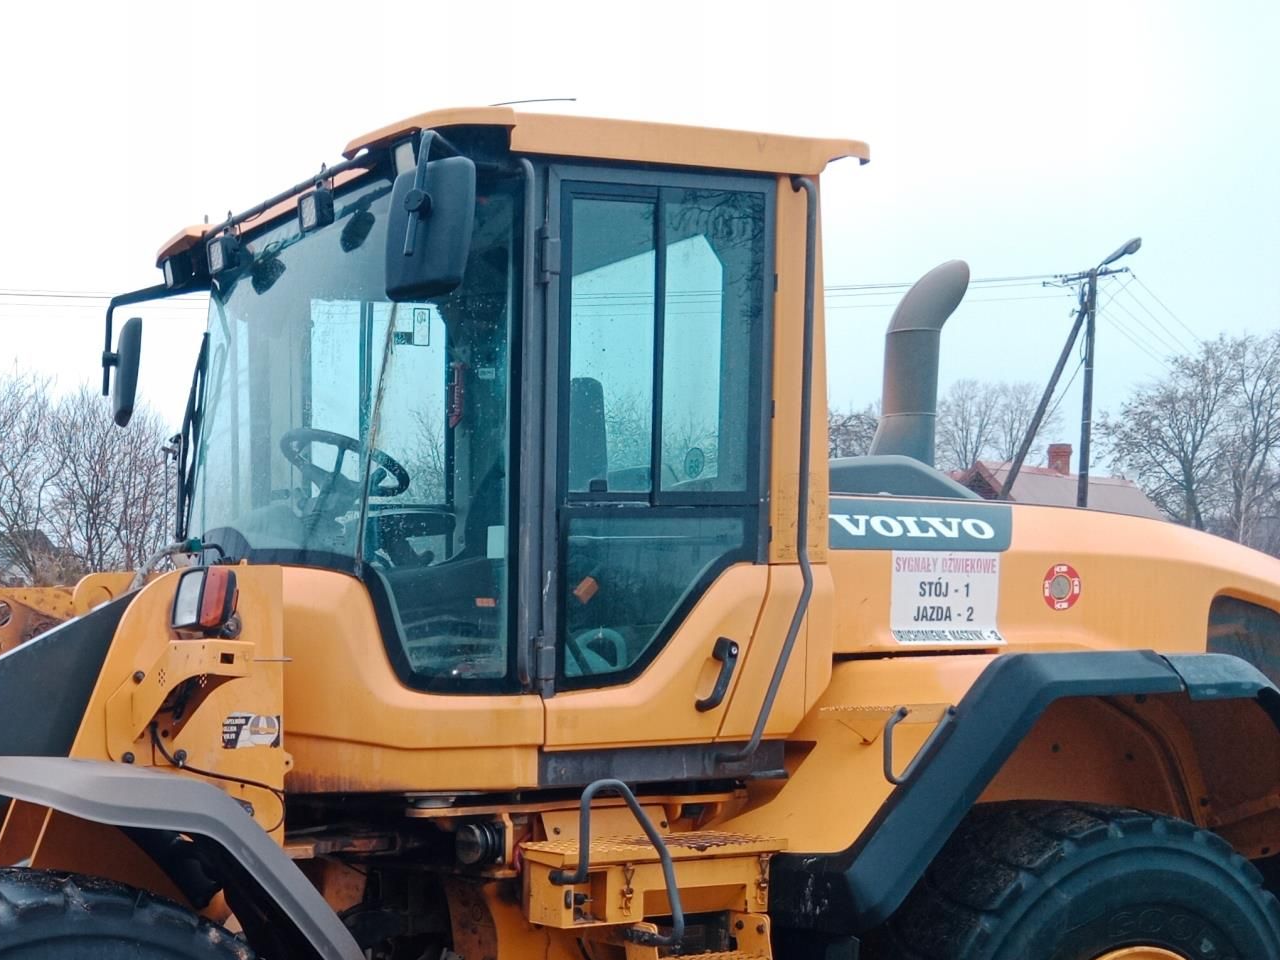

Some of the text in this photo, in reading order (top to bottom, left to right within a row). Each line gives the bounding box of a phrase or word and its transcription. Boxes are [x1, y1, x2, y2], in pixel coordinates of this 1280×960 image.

[829, 514, 995, 539] VOLVO
[895, 553, 997, 577] SYGNAŁY DŹWIĘKOWE
[918, 577, 949, 597] STÓJ
[964, 582, 971, 598] 1
[913, 606, 952, 622] JAZDA
[966, 606, 974, 622] 2
[990, 630, 1002, 641] 3
